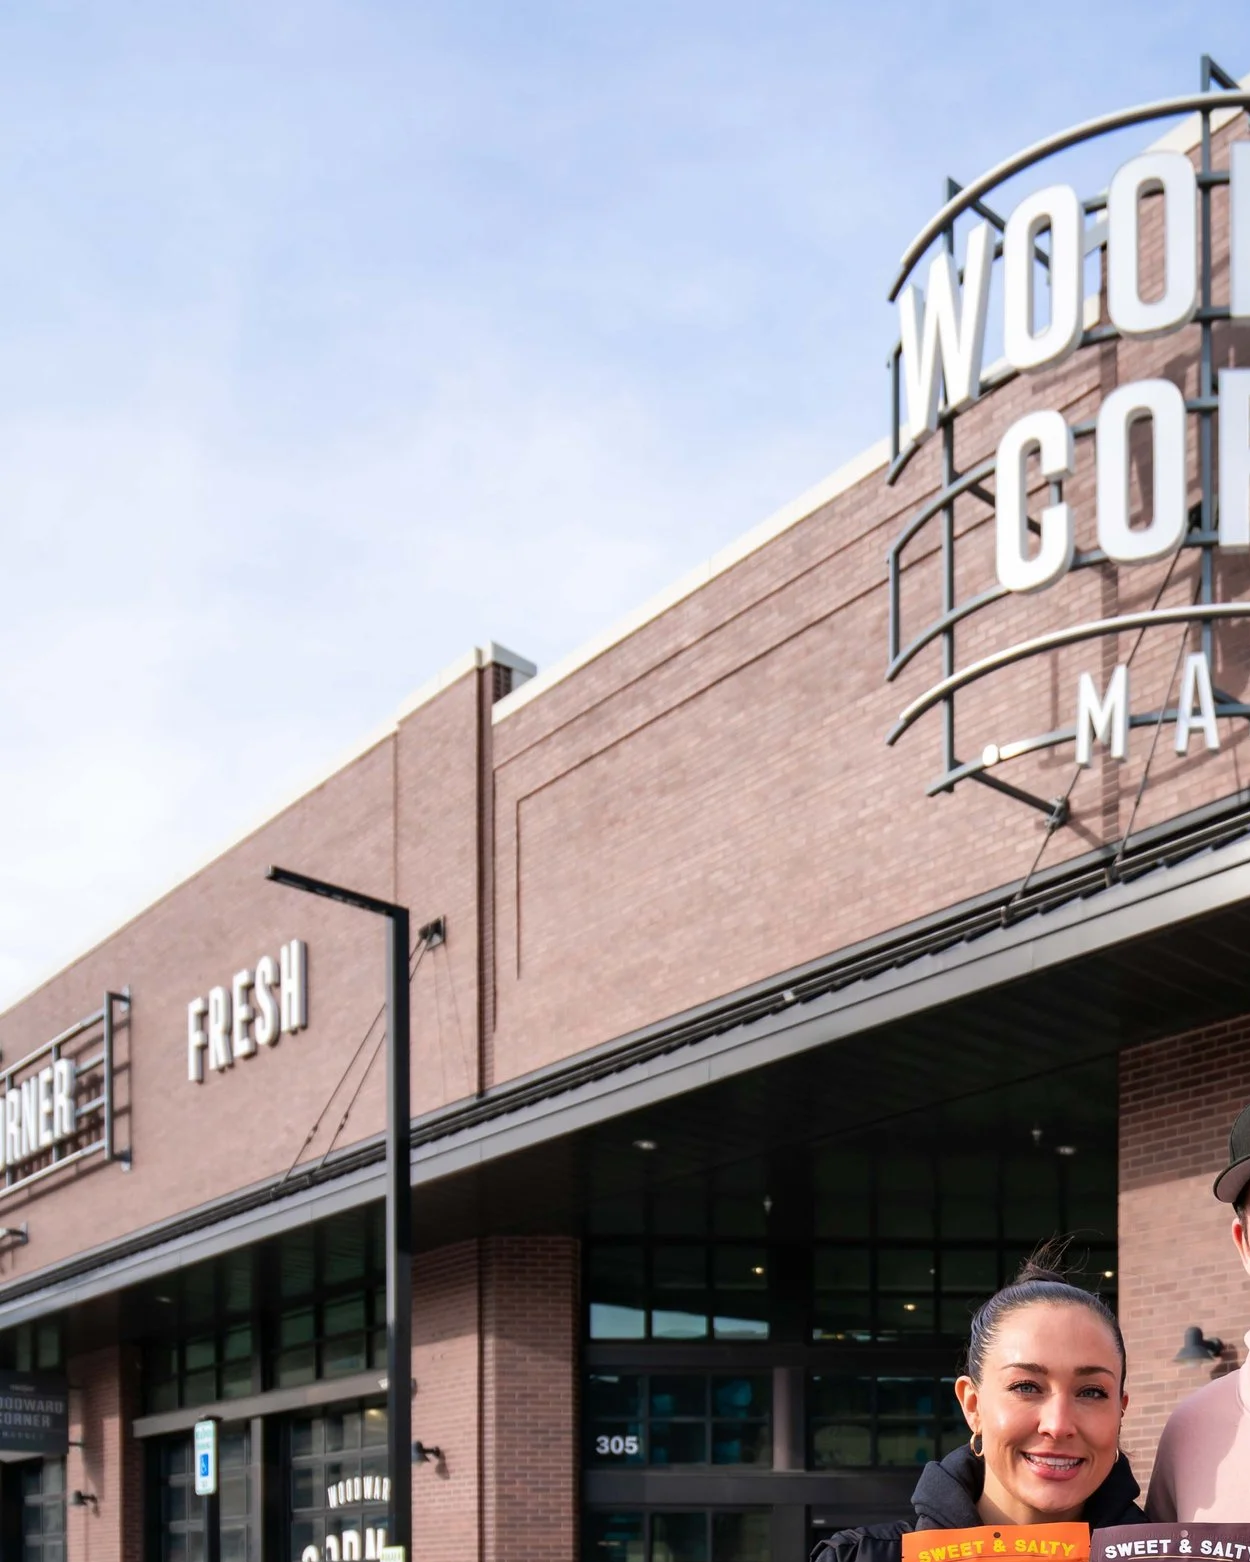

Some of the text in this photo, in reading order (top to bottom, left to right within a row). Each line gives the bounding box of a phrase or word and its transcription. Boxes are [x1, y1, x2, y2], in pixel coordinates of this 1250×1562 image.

[188, 938, 307, 1081] FRESH
[0, 1058, 76, 1169] RNER
[595, 1435, 638, 1455] 305
[328, 1476, 391, 1508] WOODWAR
[994, 1540, 1005, 1552] &
[1014, 1539, 1075, 1557] SALTY
[1105, 1540, 1171, 1559] SWEET
[1179, 1539, 1192, 1554] &
